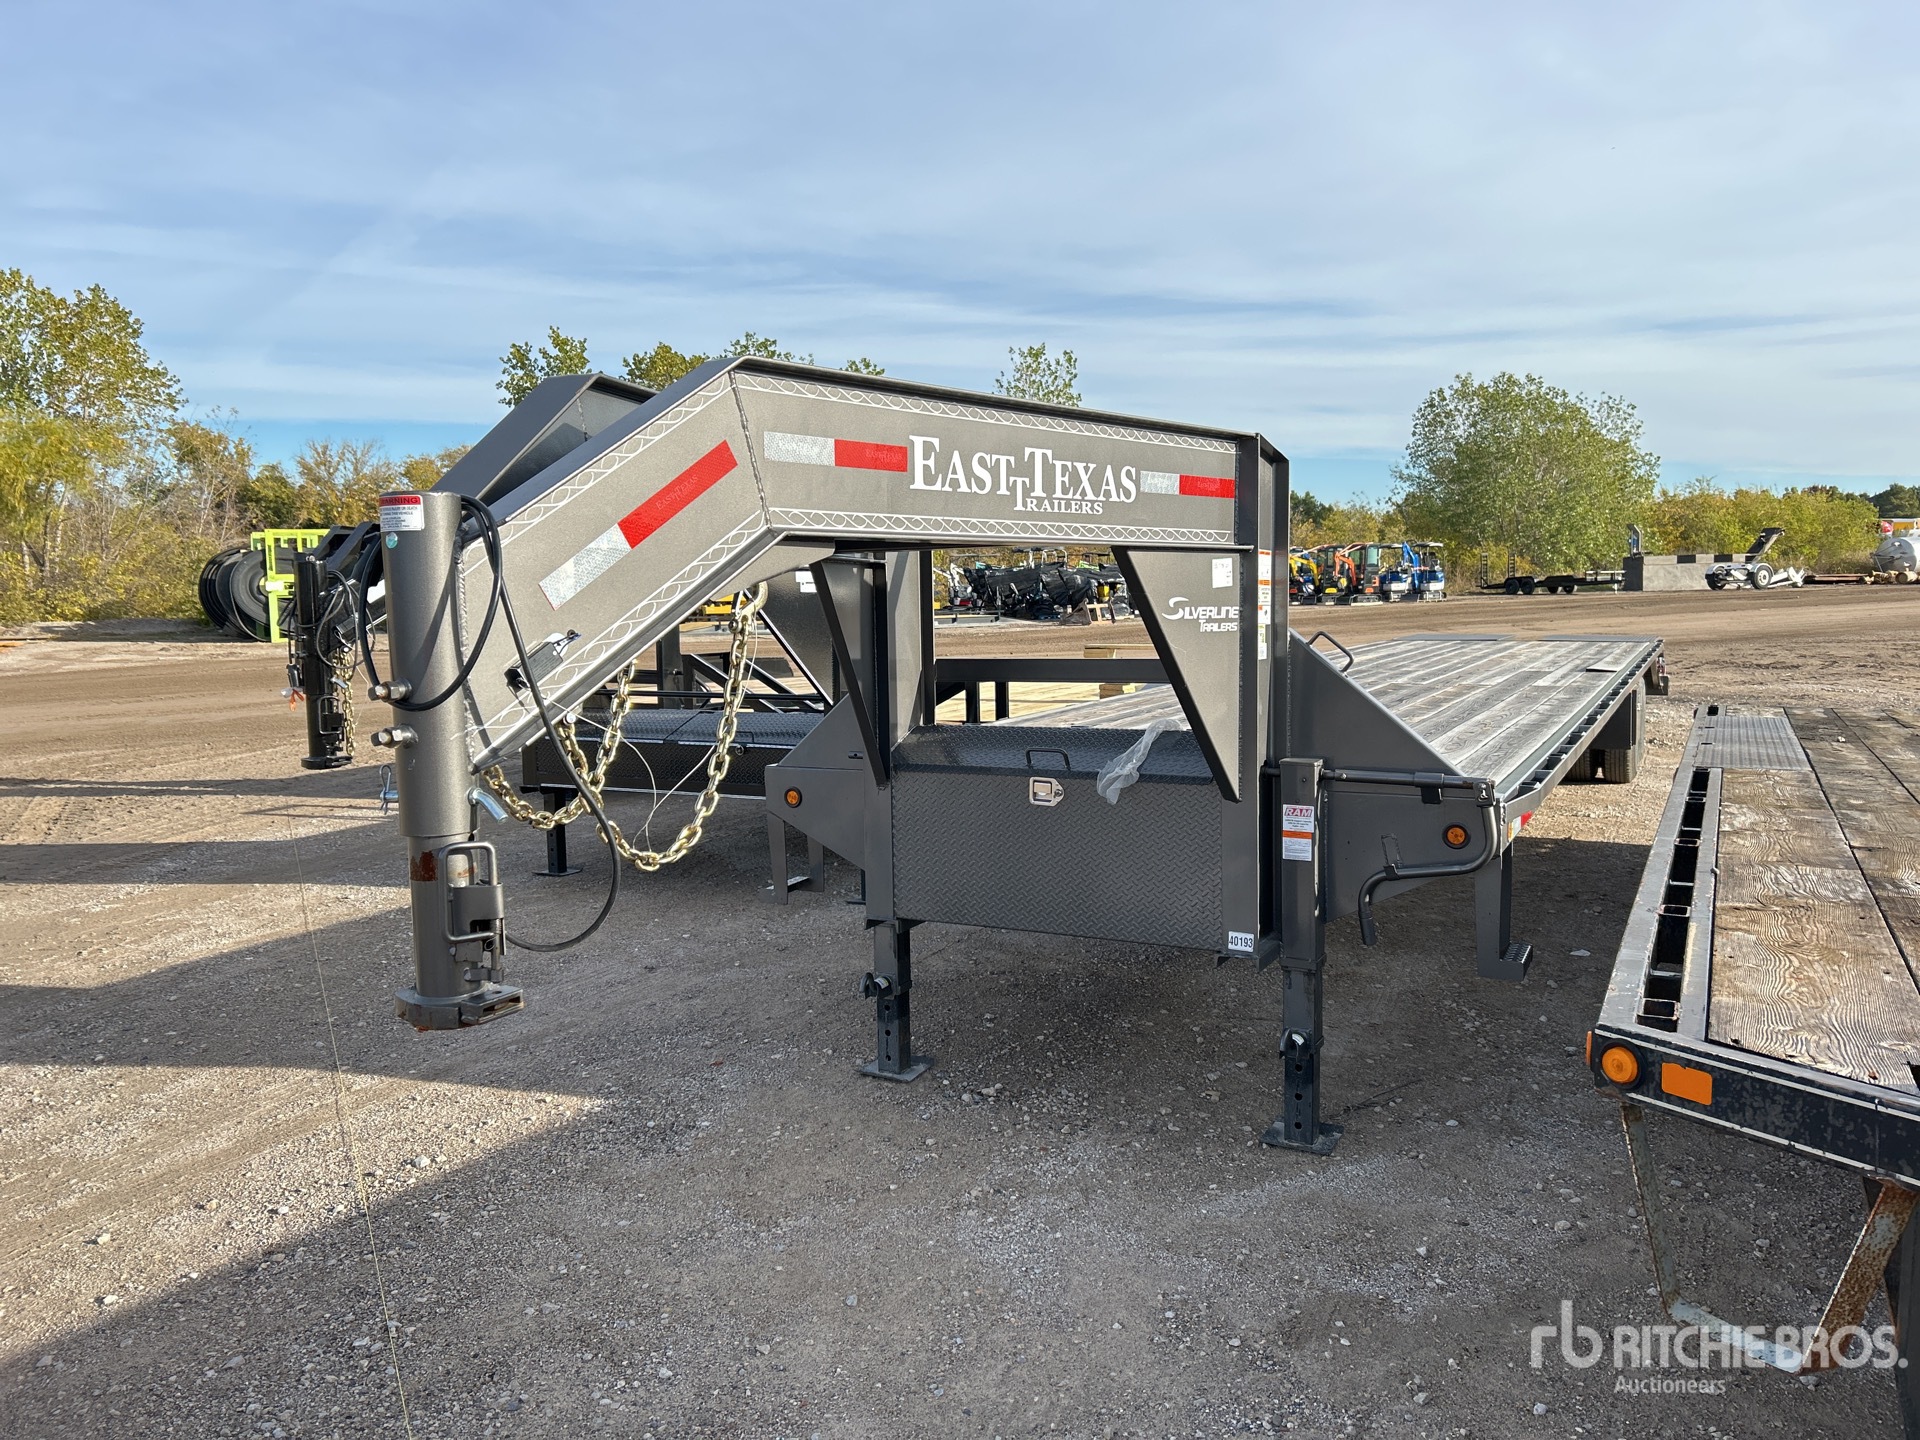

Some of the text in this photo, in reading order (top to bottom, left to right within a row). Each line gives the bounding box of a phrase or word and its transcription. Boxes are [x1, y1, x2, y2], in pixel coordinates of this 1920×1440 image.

[909, 435, 1137, 503] EAST TEXAS
[1009, 476, 1103, 515] TRAILERS
[1161, 597, 1239, 620] SILVERLINE
[1199, 620, 1238, 632] TRAILERS
[1285, 808, 1312, 818] RAM
[1228, 935, 1253, 948] 40193
